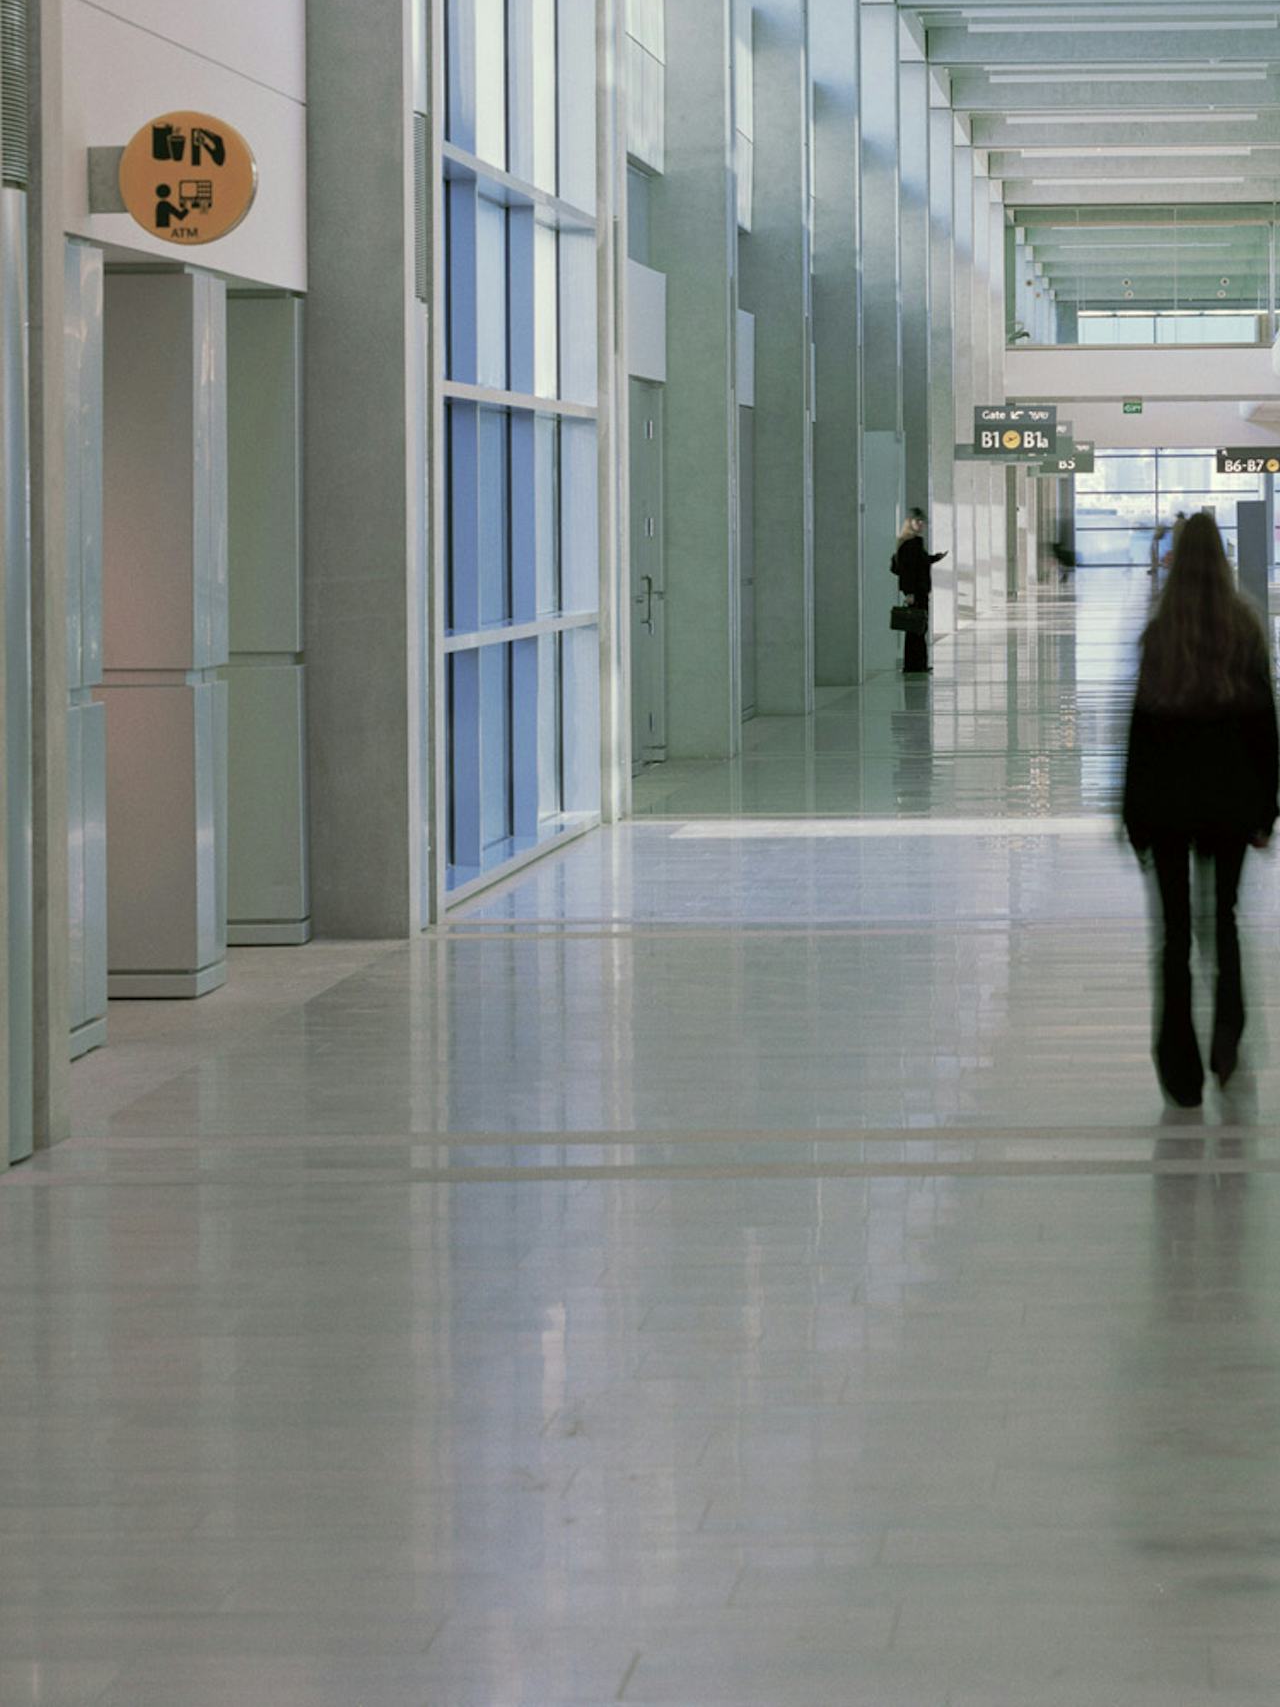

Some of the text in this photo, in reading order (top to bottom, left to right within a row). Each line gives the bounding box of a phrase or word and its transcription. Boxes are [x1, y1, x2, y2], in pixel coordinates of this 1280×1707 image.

[171, 227, 199, 239] ATM
[982, 410, 1006, 420] Gate
[981, 431, 1000, 449] B1
[1023, 431, 1049, 449] B1a
[1224, 459, 1265, 473] B6-B7
